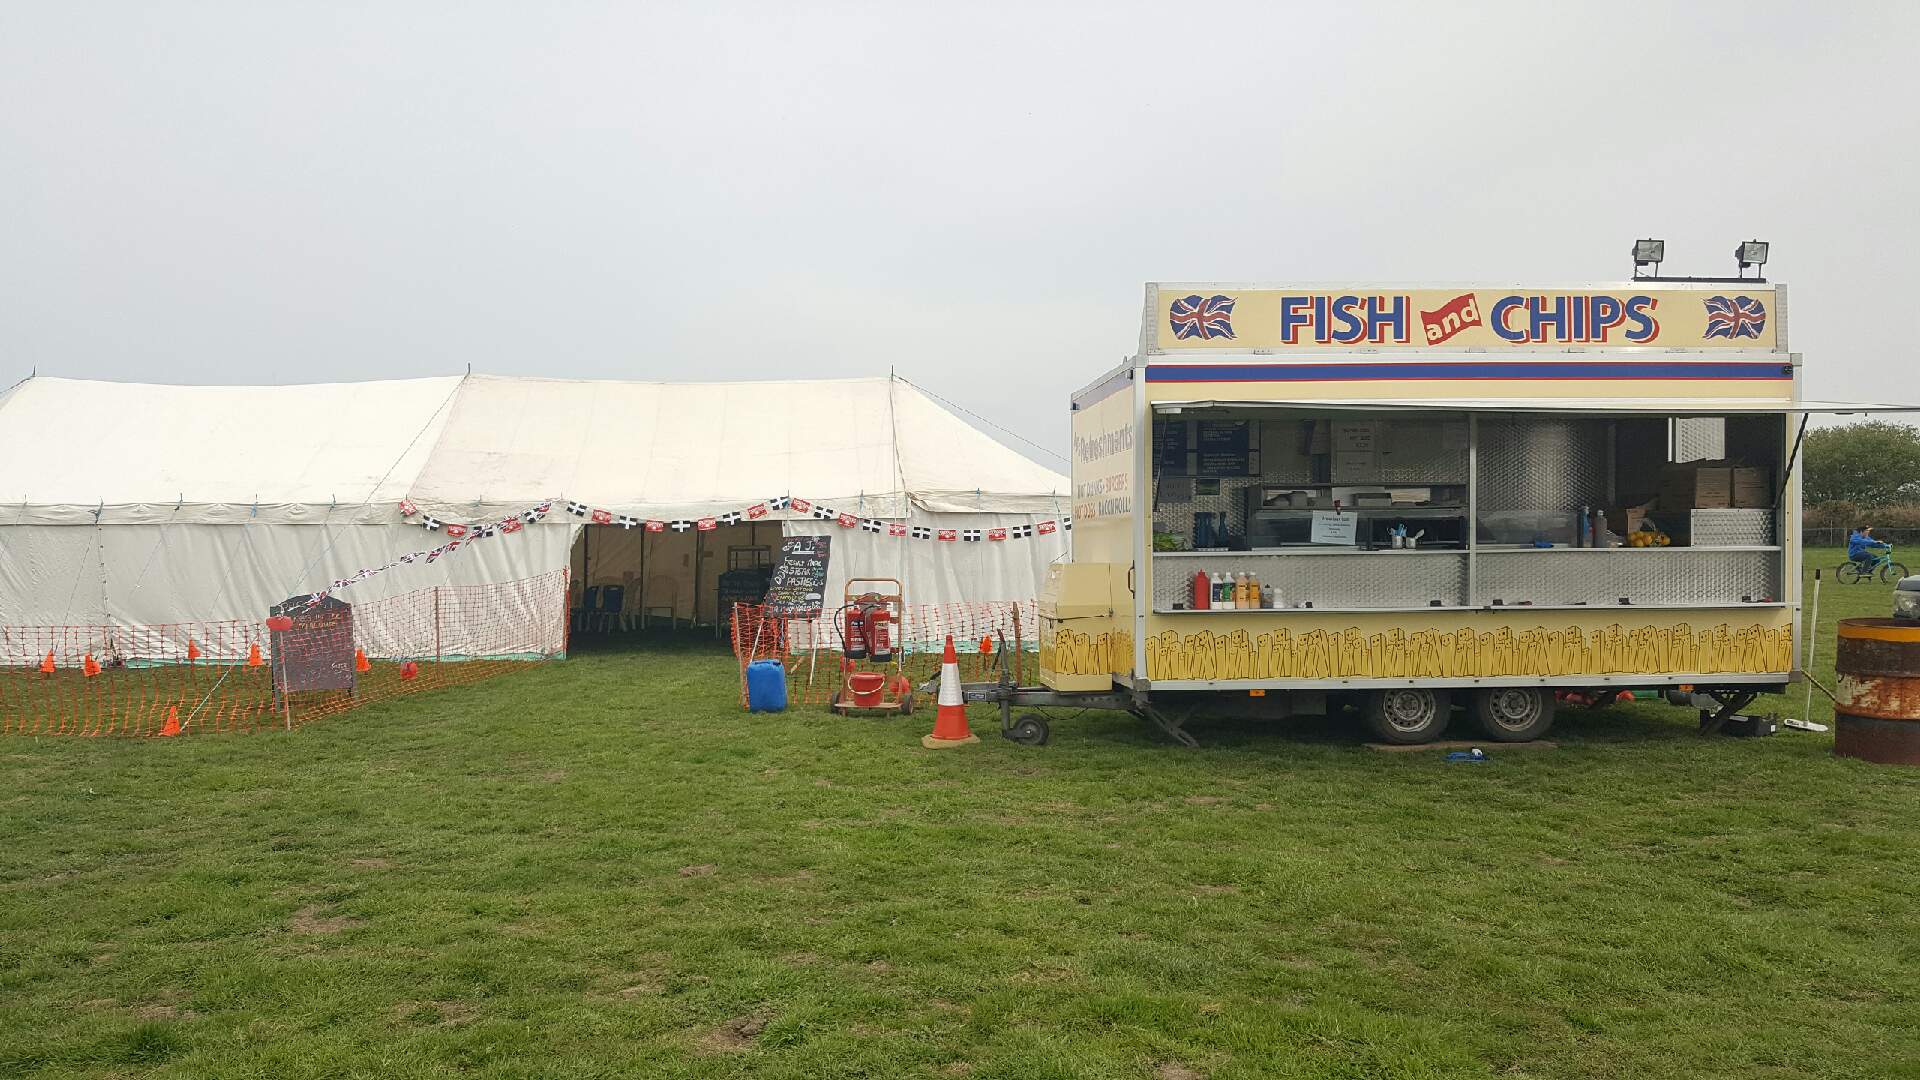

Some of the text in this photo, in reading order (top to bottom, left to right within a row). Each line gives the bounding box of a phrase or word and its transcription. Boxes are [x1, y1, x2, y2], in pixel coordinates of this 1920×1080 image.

[1280, 296, 1660, 344] FISH and CHIPS
